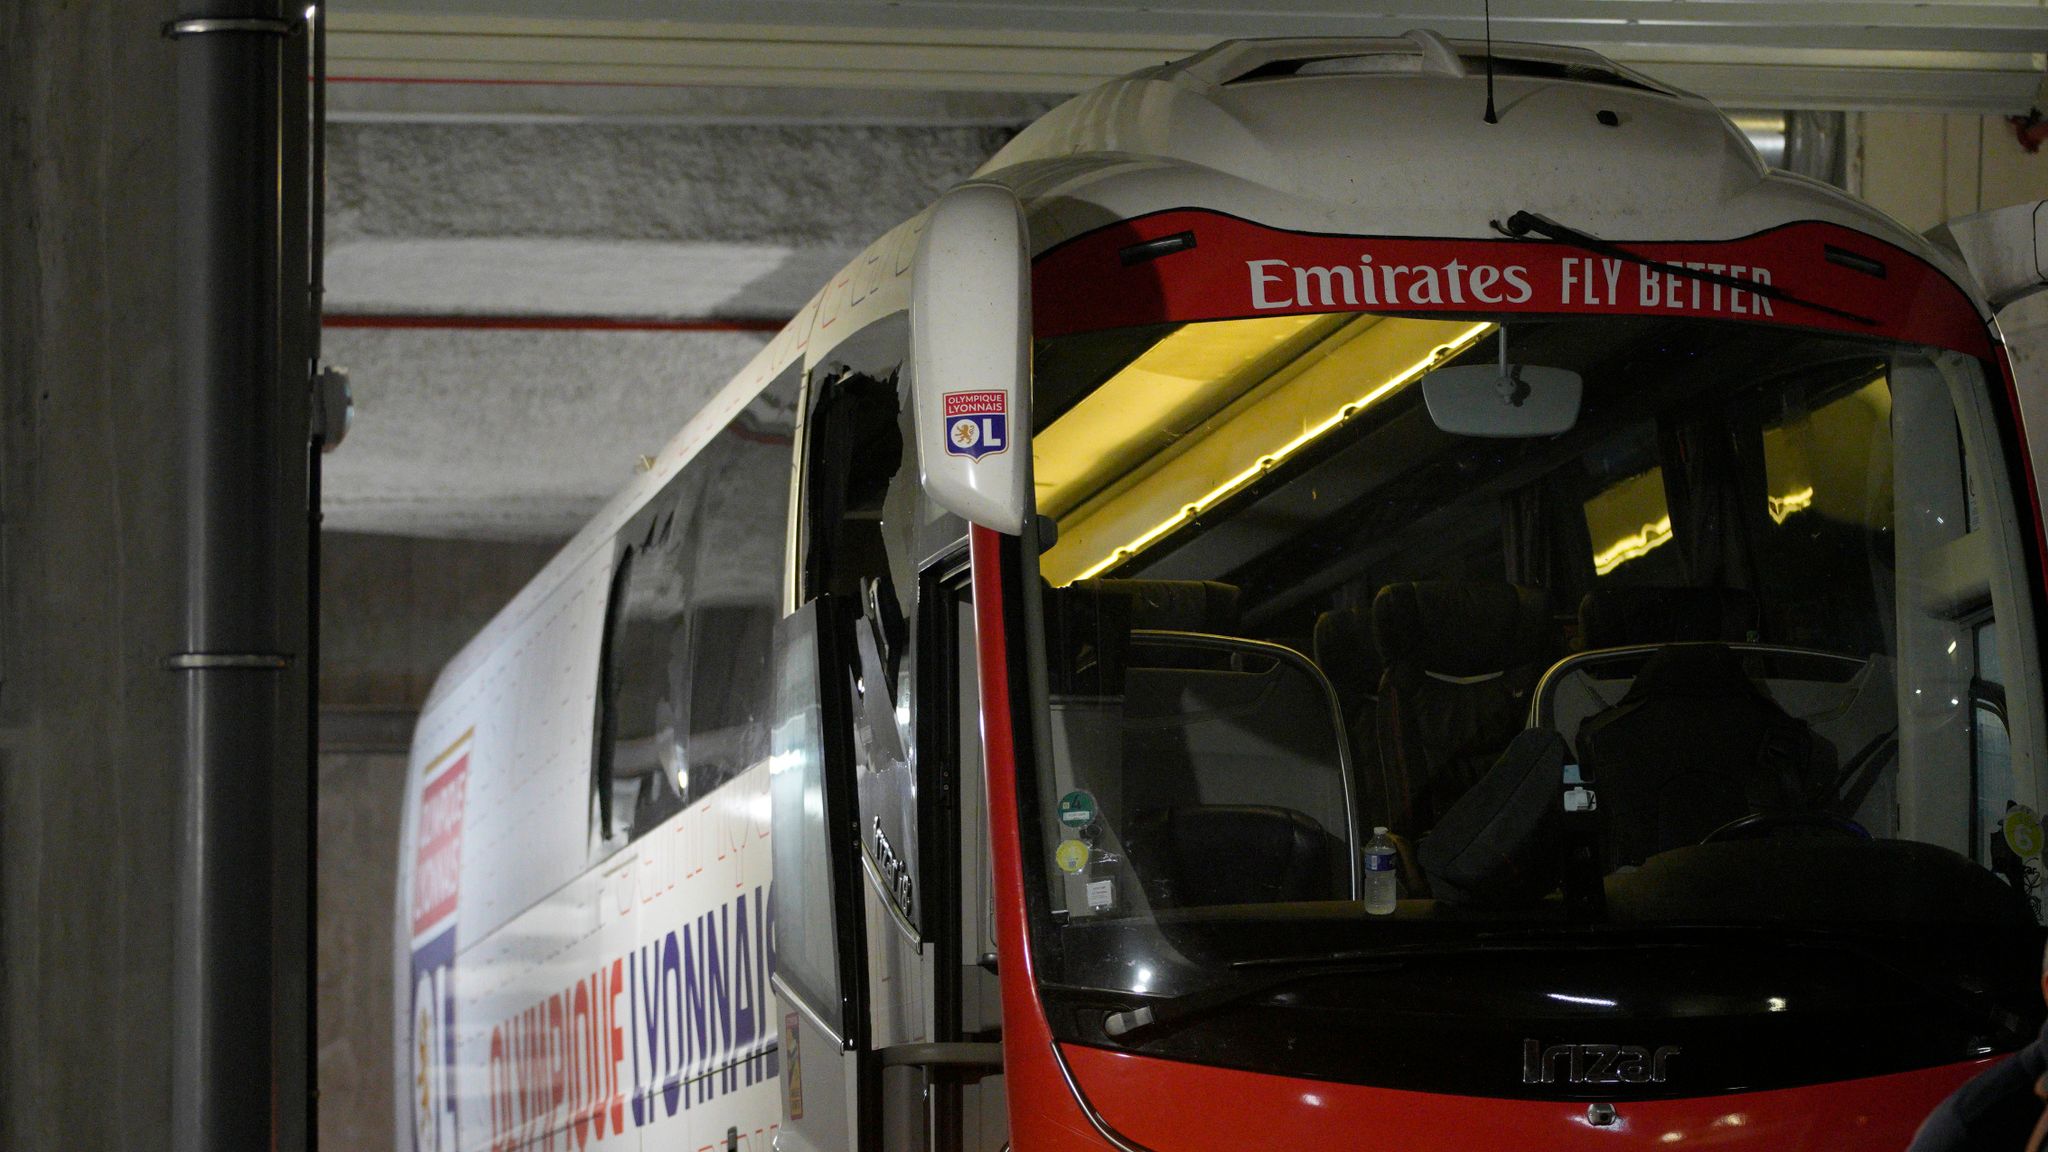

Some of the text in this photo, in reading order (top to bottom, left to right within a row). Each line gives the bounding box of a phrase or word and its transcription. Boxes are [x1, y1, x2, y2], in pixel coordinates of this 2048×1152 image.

[1246, 254, 1774, 317] Emirates FLY BETTER
[948, 394, 1002, 404] OLYMPIQUE
[948, 403, 1002, 414] LYONNAIS
[489, 957, 624, 1152] OLYMPIQUE
[1523, 1038, 1681, 1083] Irizar
